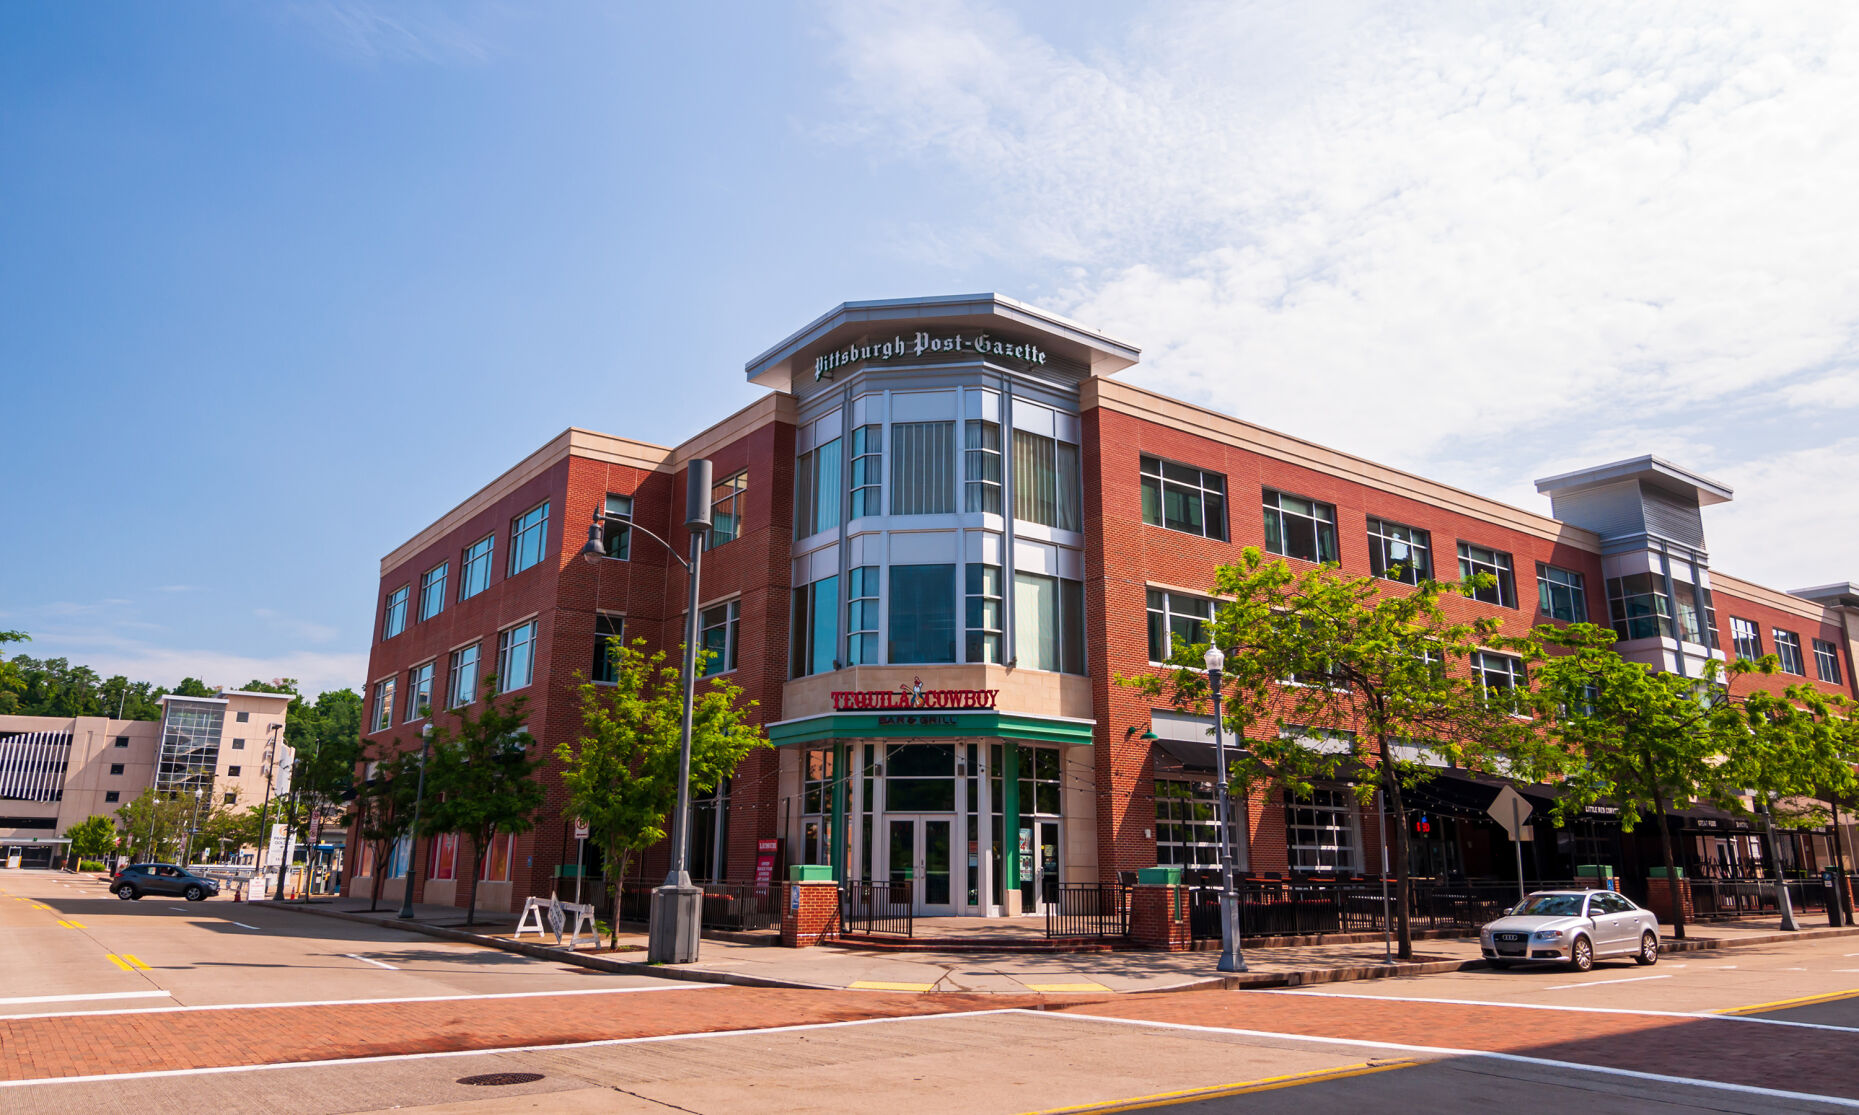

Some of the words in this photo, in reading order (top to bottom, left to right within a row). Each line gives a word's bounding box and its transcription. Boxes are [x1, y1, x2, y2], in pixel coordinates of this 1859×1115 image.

[814, 336, 905, 381] Pittsburgh
[914, 331, 1047, 365] Post-Gazette
[831, 691, 911, 709] TEQUILA
[925, 689, 999, 708] COWBOY
[878, 717, 905, 725] BAR
[920, 716, 958, 725] GRILL
